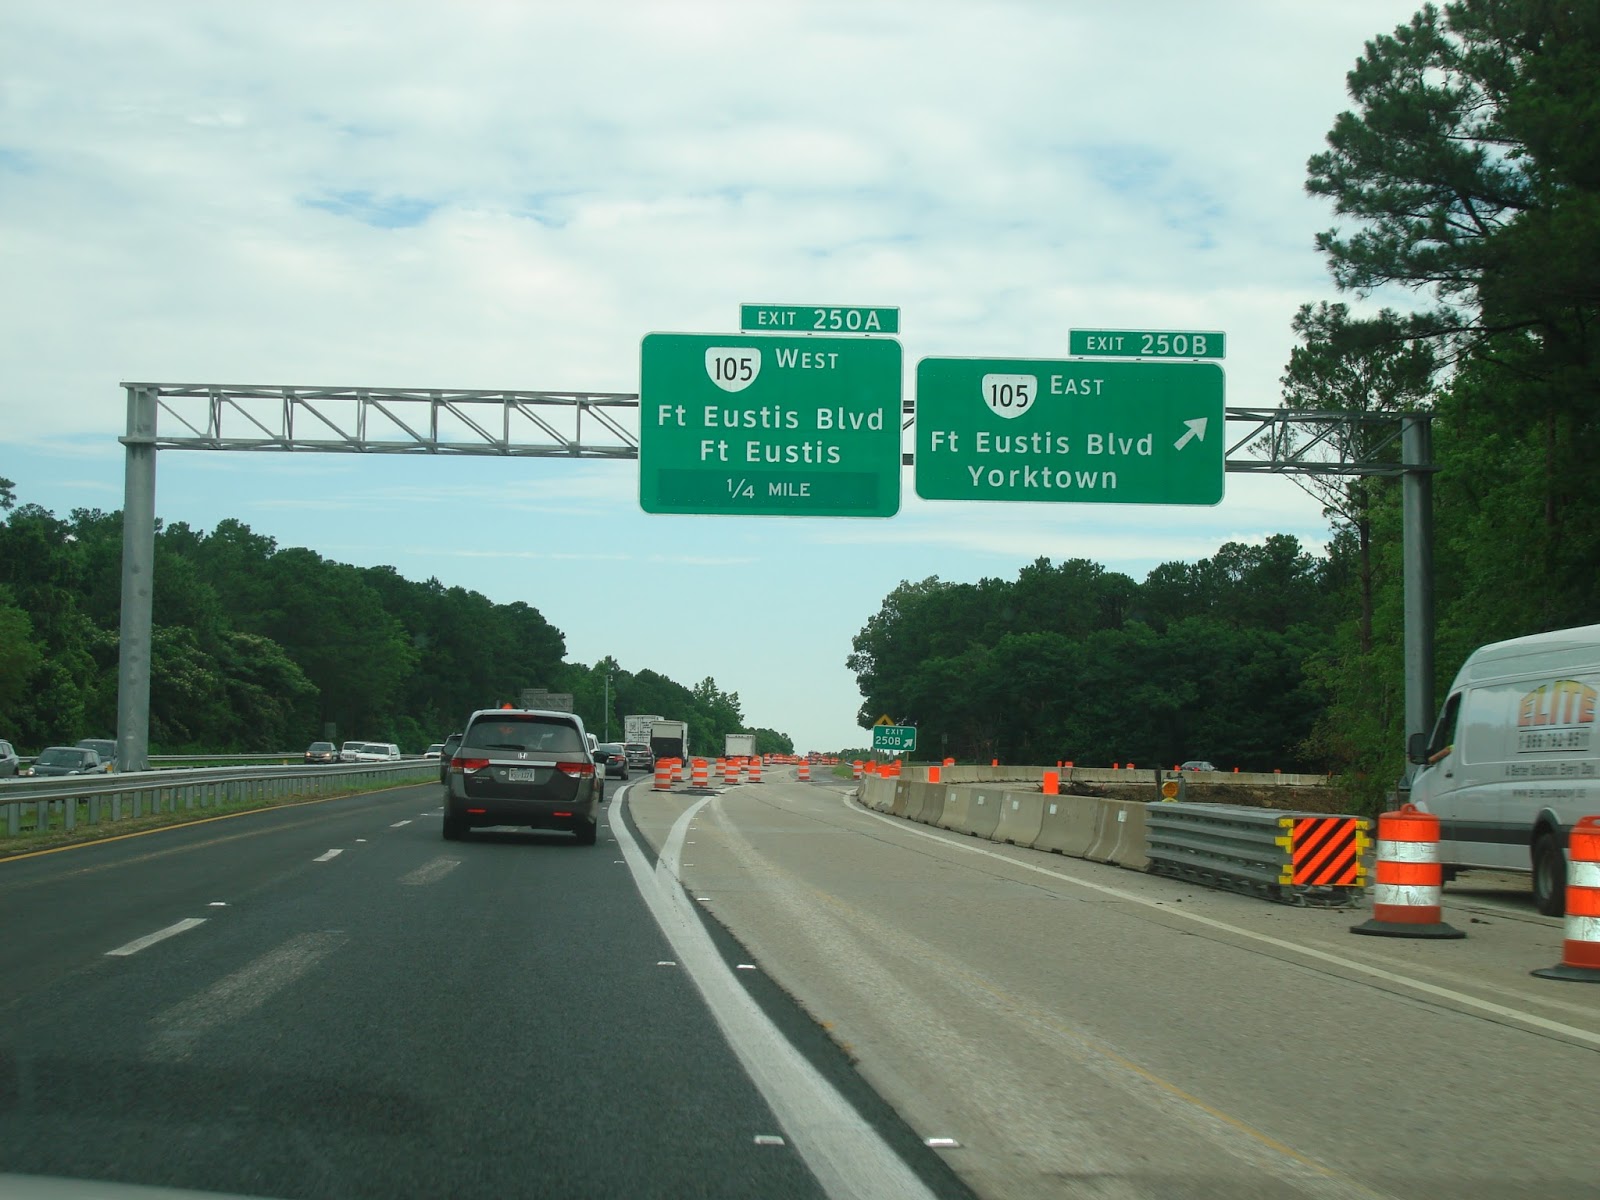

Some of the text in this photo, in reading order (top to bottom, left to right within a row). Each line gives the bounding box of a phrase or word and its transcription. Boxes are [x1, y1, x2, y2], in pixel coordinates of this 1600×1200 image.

[757, 310, 881, 330] EXIT 250A
[1087, 334, 1207, 355] EXIT 250B
[715, 348, 839, 381] 105 WEST
[992, 375, 1104, 408] 105 EAST
[659, 405, 883, 430] Ft Eustis Blvd
[700, 440, 841, 463] Ft Eustis
[931, 431, 1152, 455] Ft Eustis Blvd
[726, 478, 811, 498] 1/4 MILE
[968, 465, 1116, 489] Yorktown
[1518, 680, 1597, 727] ELITE
[876, 736, 901, 746] 250B
